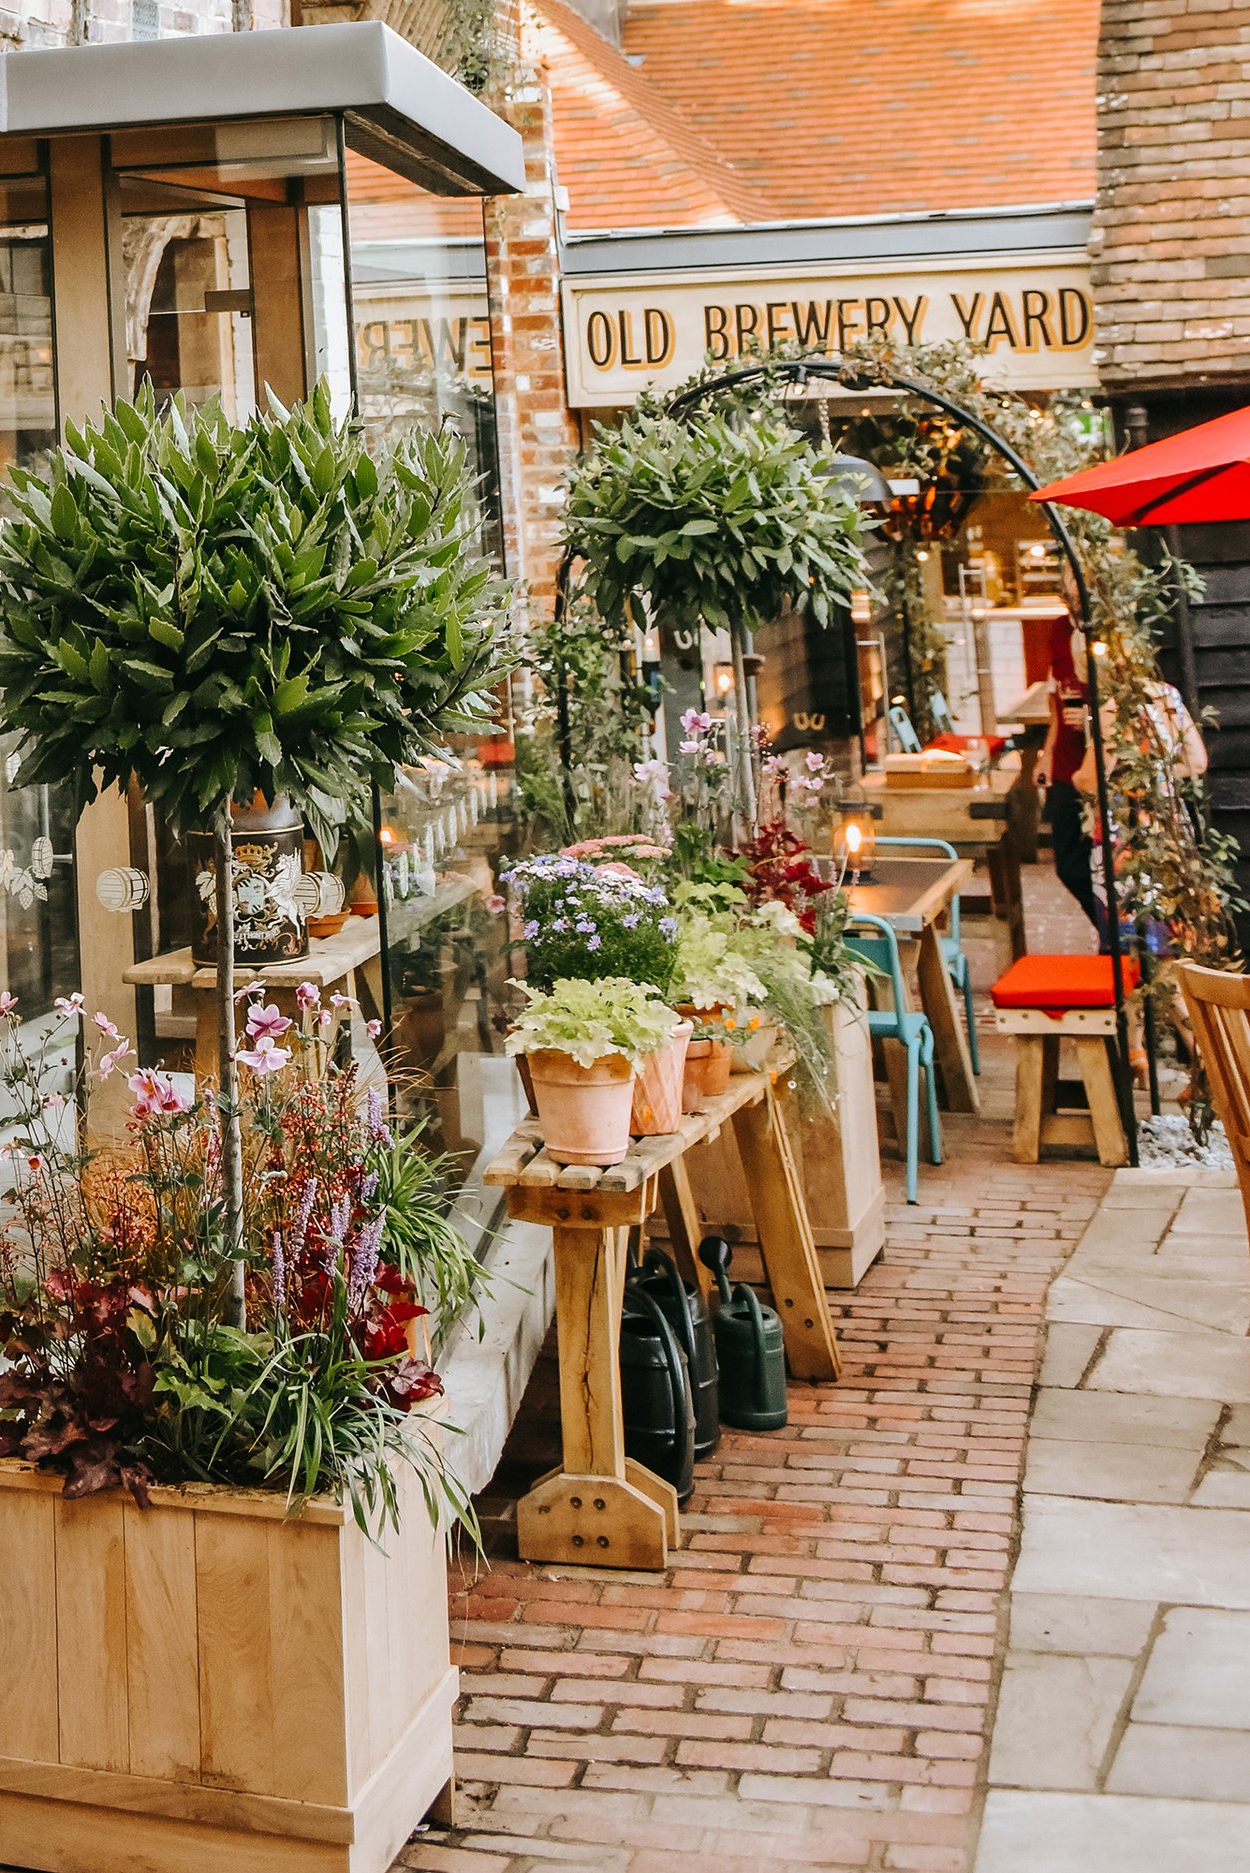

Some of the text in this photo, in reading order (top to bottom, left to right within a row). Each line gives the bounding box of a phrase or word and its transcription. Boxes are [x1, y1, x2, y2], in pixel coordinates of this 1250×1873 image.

[586, 287, 1093, 372] OLD BREWERY YARD
